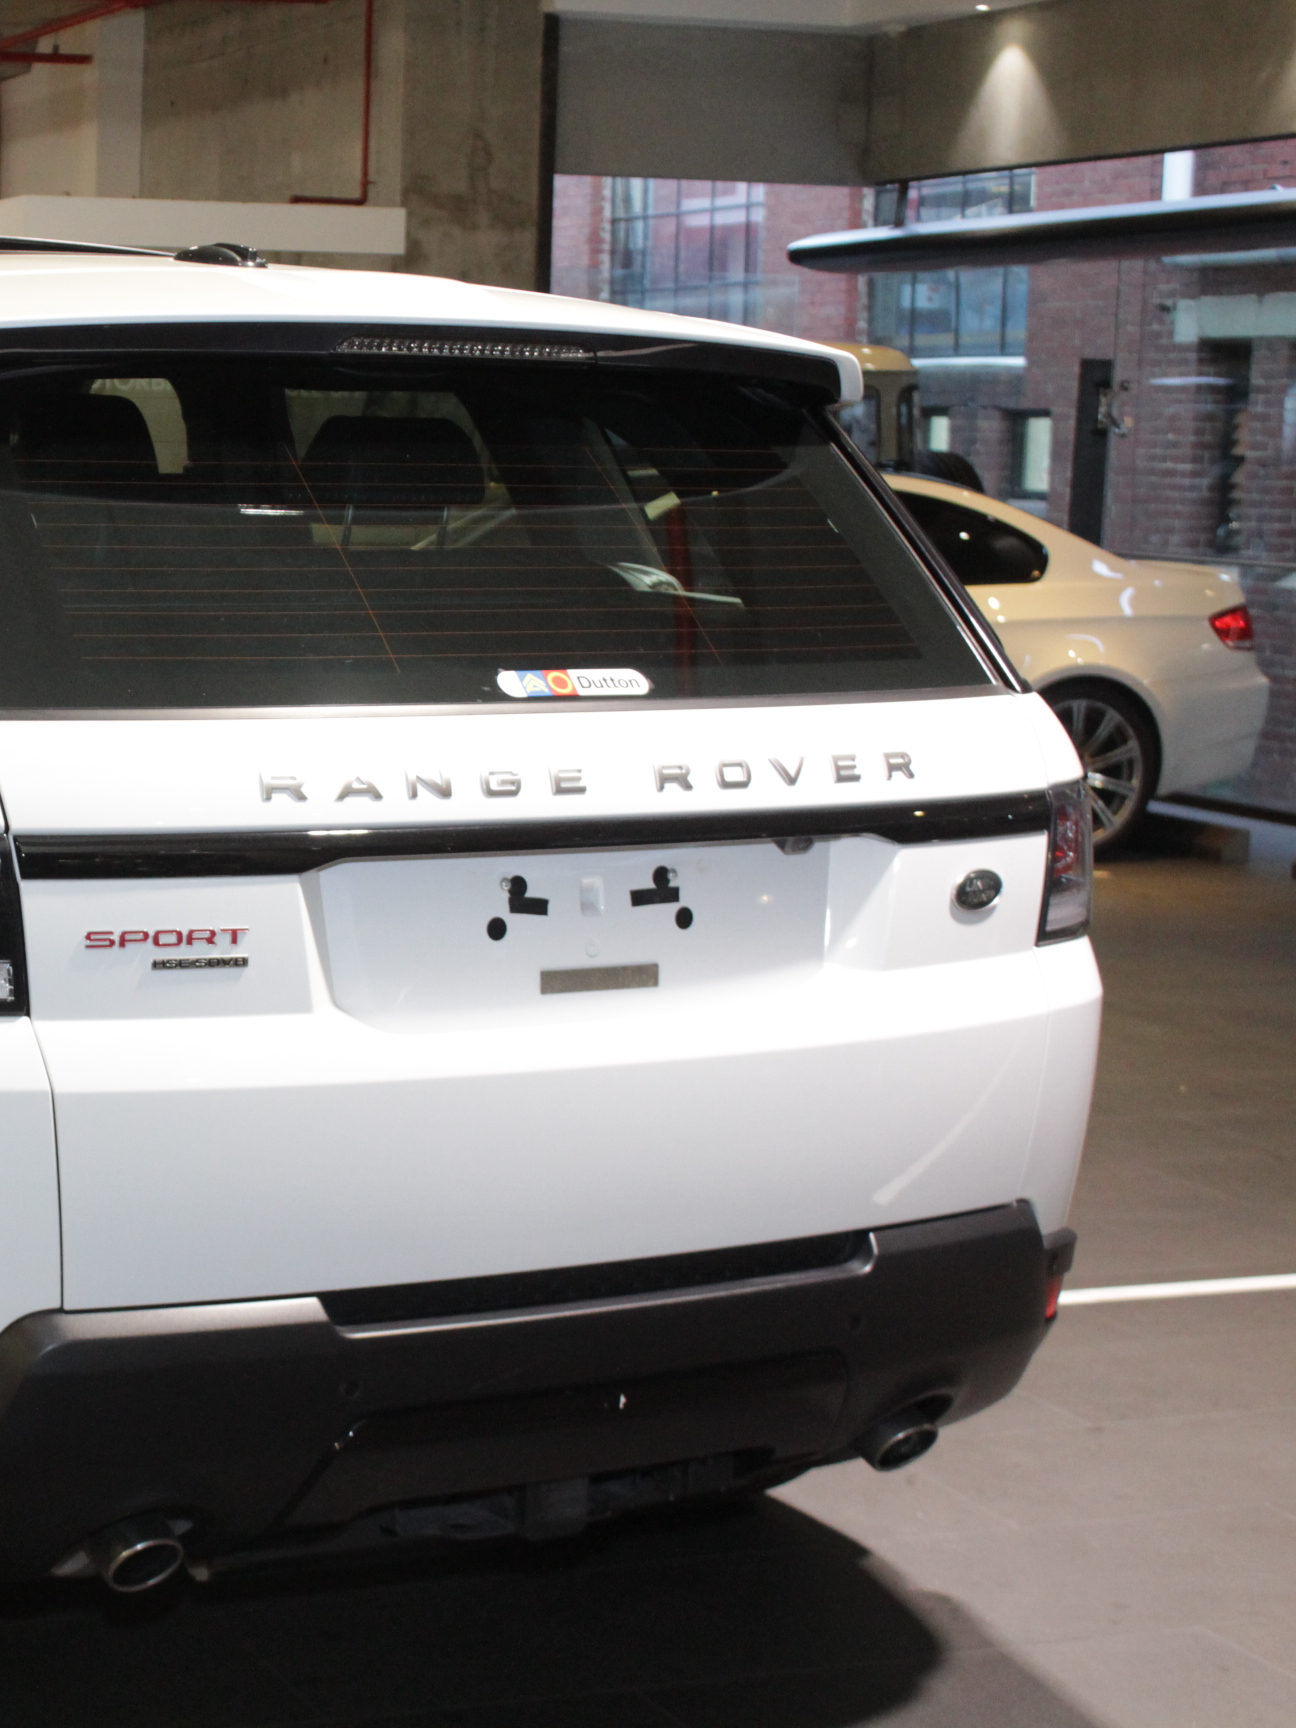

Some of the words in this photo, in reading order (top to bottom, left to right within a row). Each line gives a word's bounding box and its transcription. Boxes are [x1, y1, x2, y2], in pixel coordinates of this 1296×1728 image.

[577, 676, 641, 689] Dutton
[260, 767, 587, 802] RANGE
[655, 751, 915, 793] ROVER
[85, 927, 249, 948] SPORT
[153, 959, 191, 969] HSE
